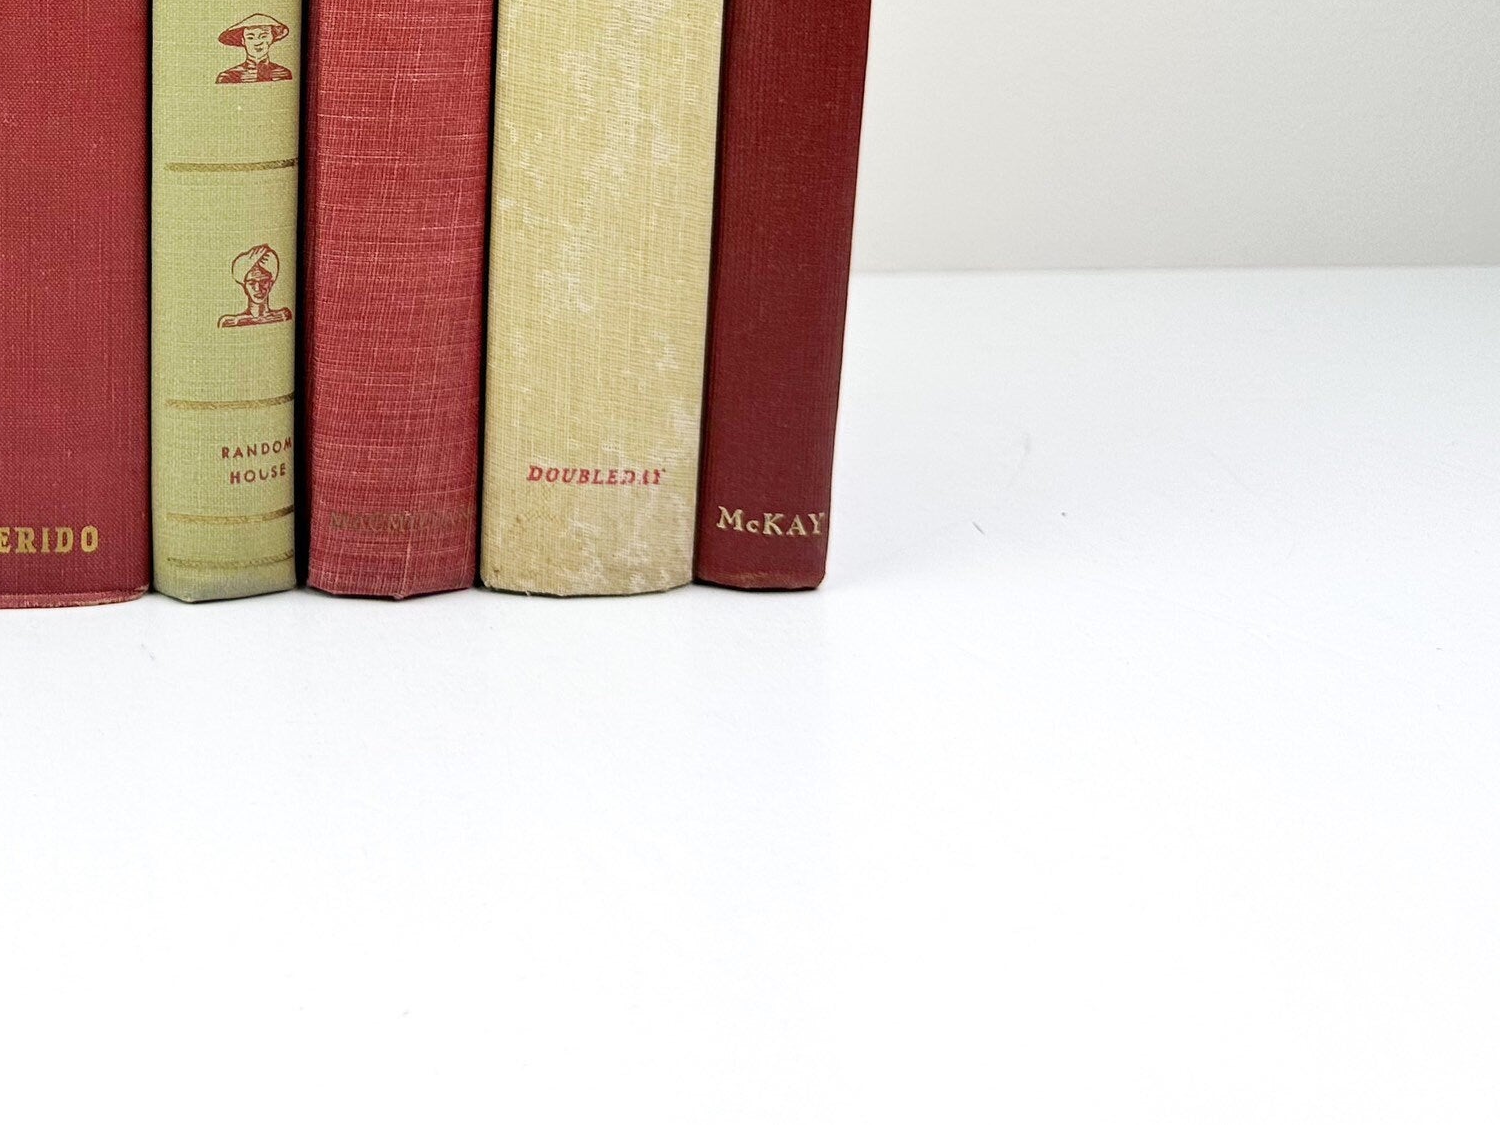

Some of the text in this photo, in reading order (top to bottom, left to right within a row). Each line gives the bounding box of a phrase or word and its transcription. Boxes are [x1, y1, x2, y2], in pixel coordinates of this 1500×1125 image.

[221, 436, 292, 459] RANDOM
[229, 462, 287, 485] HOUSE
[716, 505, 826, 536] McKAY
